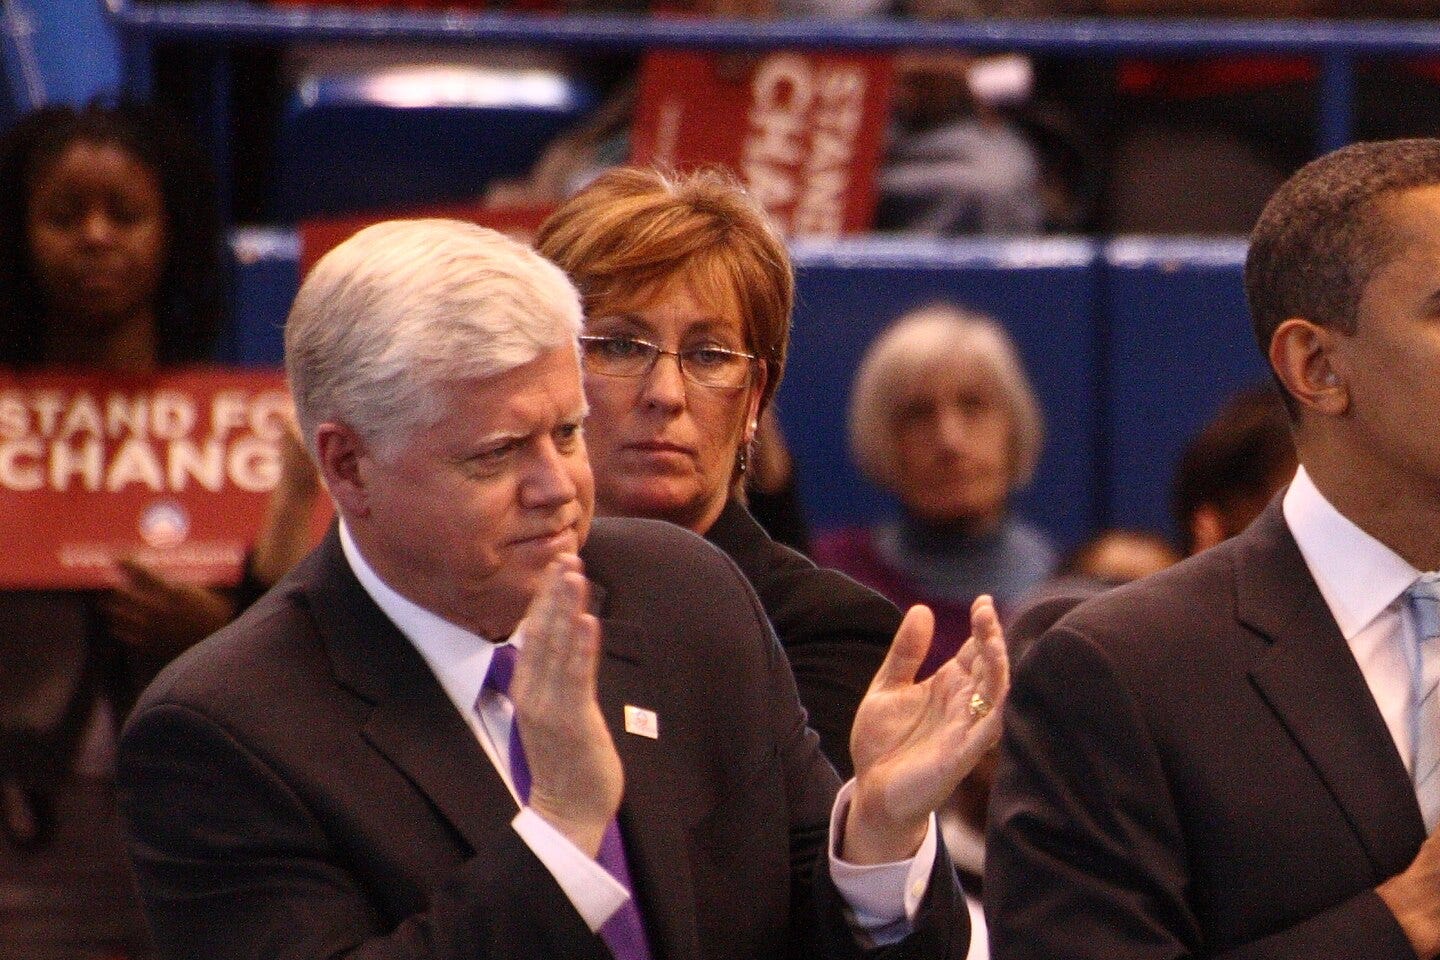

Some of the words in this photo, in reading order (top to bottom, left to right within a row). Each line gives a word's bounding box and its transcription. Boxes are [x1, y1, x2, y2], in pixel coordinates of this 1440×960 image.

[0, 389, 197, 440] STAND
[210, 389, 290, 440] FO
[0, 438, 282, 493] CHANG
